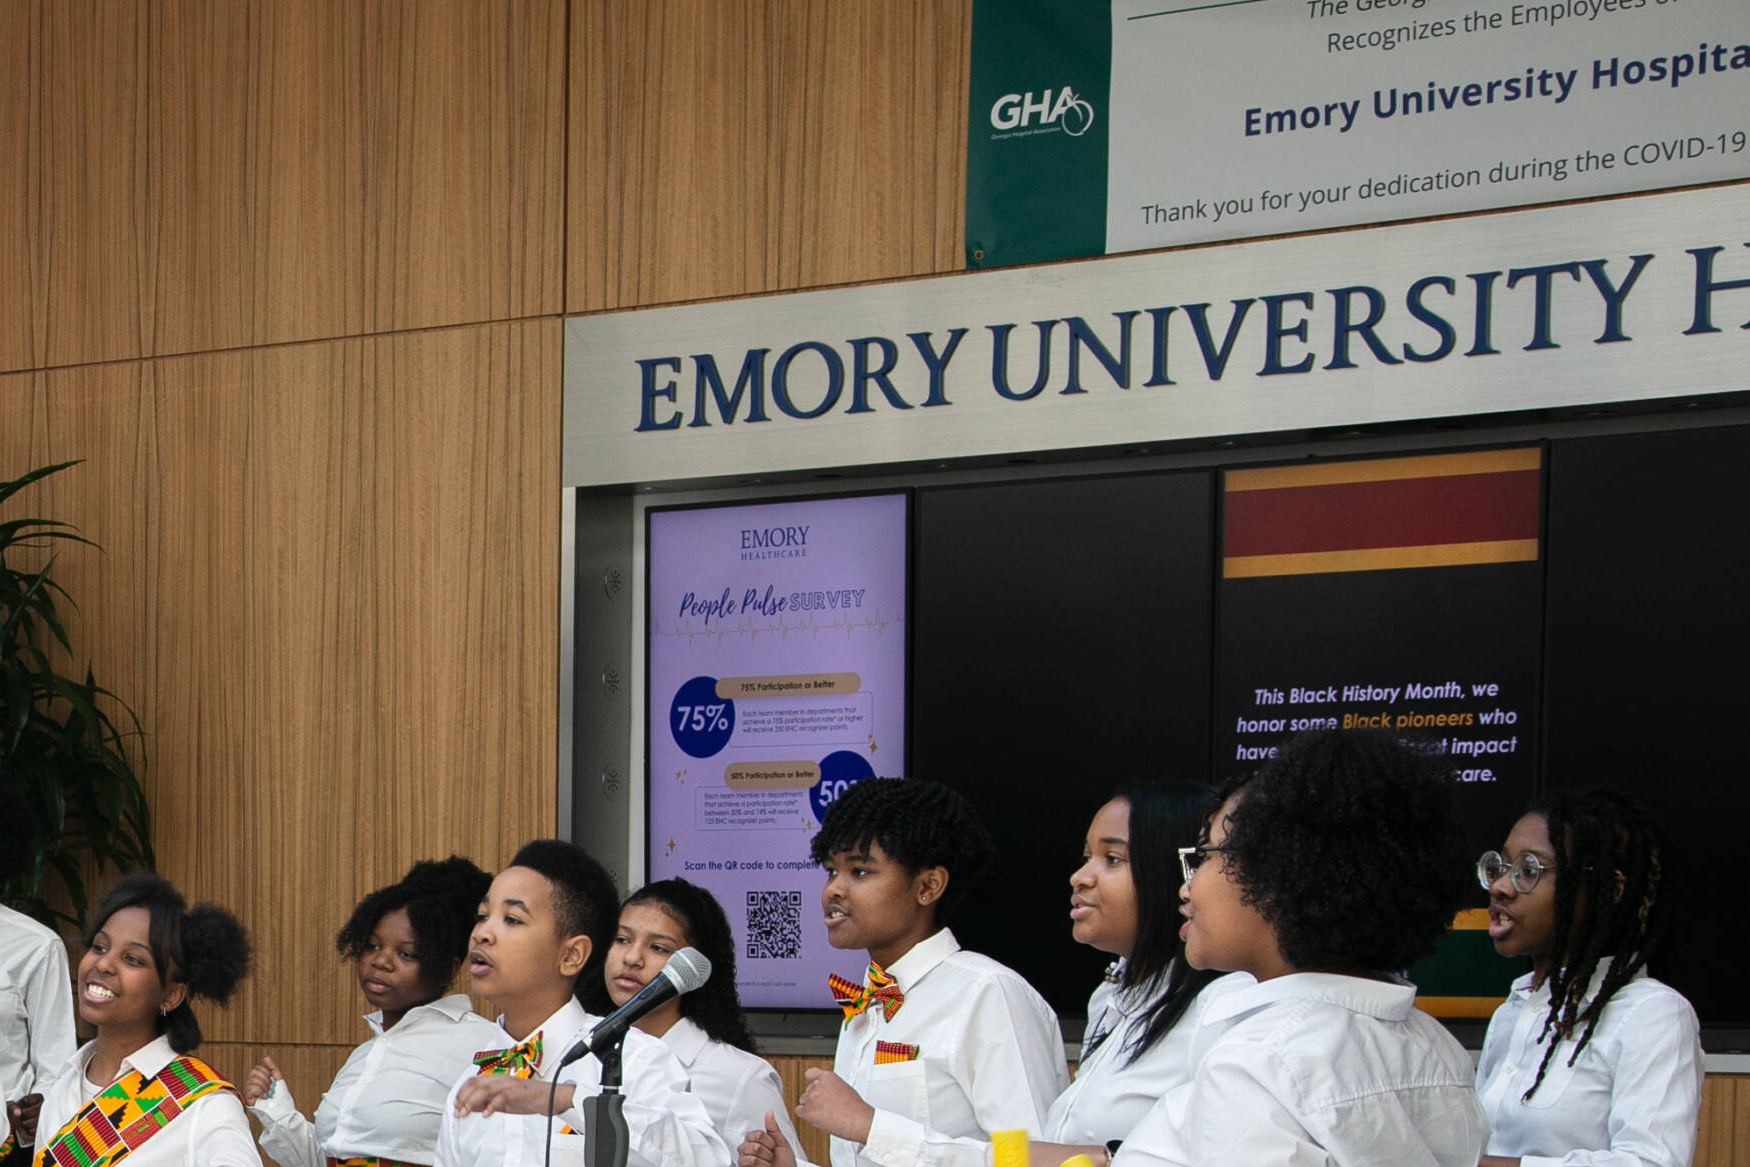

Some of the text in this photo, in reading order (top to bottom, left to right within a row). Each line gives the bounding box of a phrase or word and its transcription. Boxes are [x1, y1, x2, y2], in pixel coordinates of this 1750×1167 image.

[1307, 0, 1349, 18] The
[1327, 19, 1456, 53] Recognizes
[1463, 9, 1502, 34] the
[1244, 42, 1750, 137] Emory University Hospita
[991, 86, 1076, 130] GHA
[1141, 131, 1747, 225] Thank you for your dedication during the COVID-19
[634, 328, 970, 433] EMORY
[985, 254, 1656, 401] UNIVERSITY
[740, 526, 810, 550] EMORY
[740, 548, 807, 561] HEALTHCARE
[678, 584, 866, 626] People Pulse SURVEY
[740, 683, 756, 692] 75%
[757, 681, 802, 692] Participation
[813, 680, 835, 689] Better
[1253, 681, 1499, 705] This Black History Month, we
[677, 703, 729, 732] 75%
[1236, 716, 1287, 733] honor
[1343, 712, 1391, 730] Black
[1396, 710, 1474, 732] pioneers
[1478, 708, 1518, 725] who
[1451, 736, 1518, 758] impact
[745, 771, 786, 780] Participation
[795, 770, 814, 778] Better
[819, 780, 858, 807] 50
[684, 860, 706, 871] Scan
[708, 860, 723, 870] the
[724, 860, 738, 871] QR
[740, 860, 763, 870] code
[766, 860, 775, 870] to
